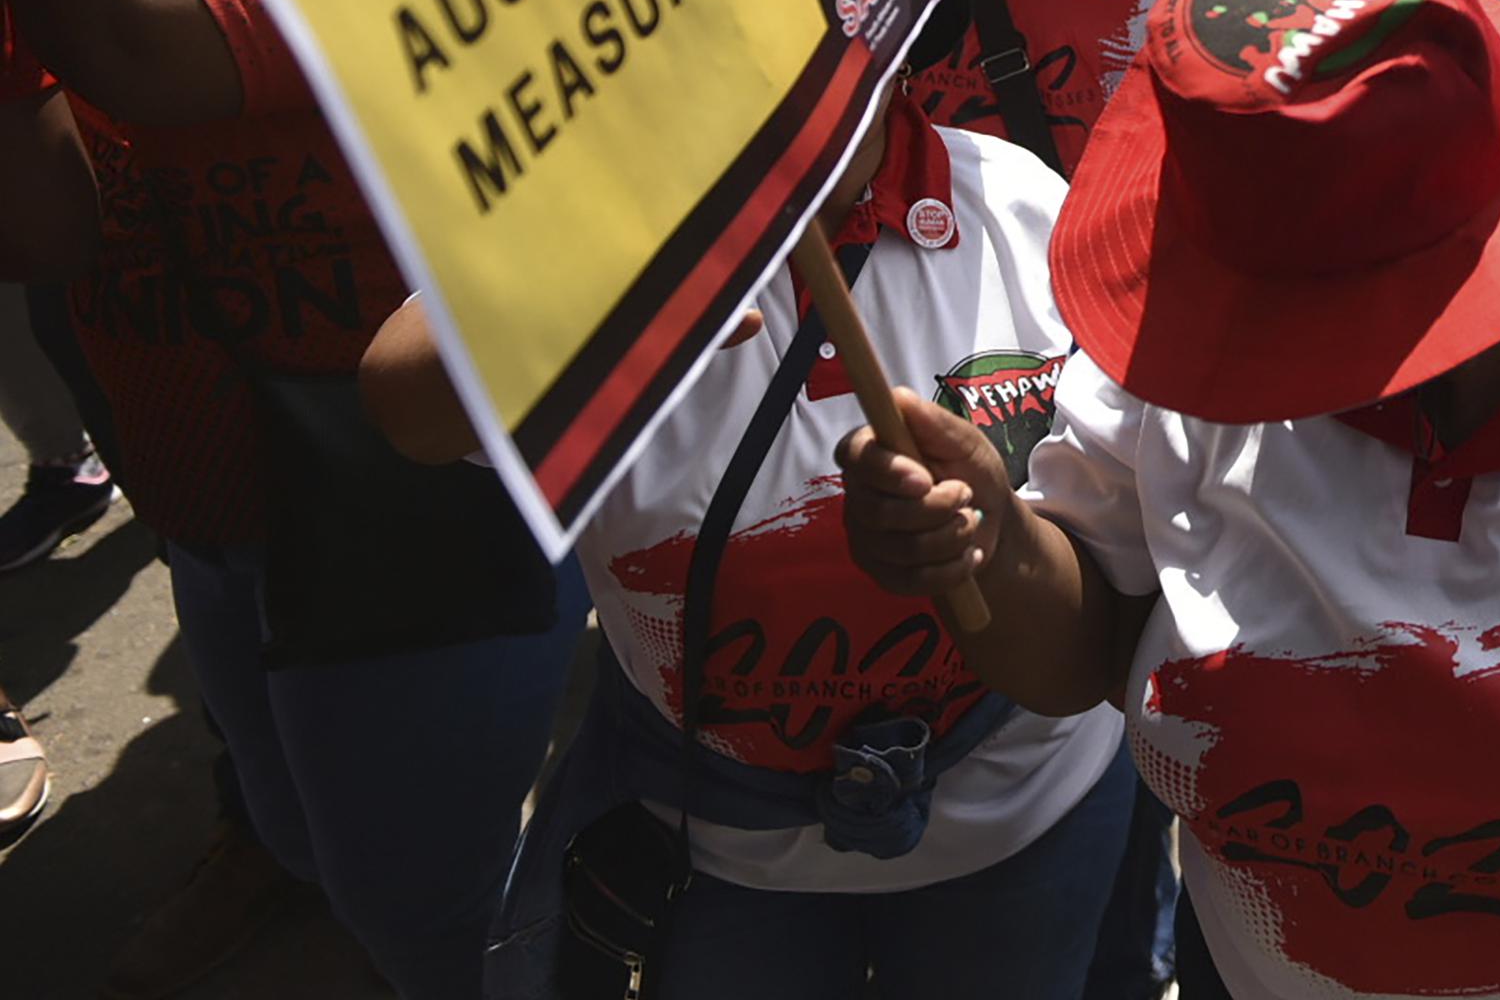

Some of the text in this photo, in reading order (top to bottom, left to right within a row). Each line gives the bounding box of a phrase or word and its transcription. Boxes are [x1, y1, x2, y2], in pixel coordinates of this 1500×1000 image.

[734, 679, 764, 698] OF
[773, 680, 872, 701] BRANCH
[1271, 833, 1306, 852] OF
[1317, 842, 1437, 880] BRANCH
